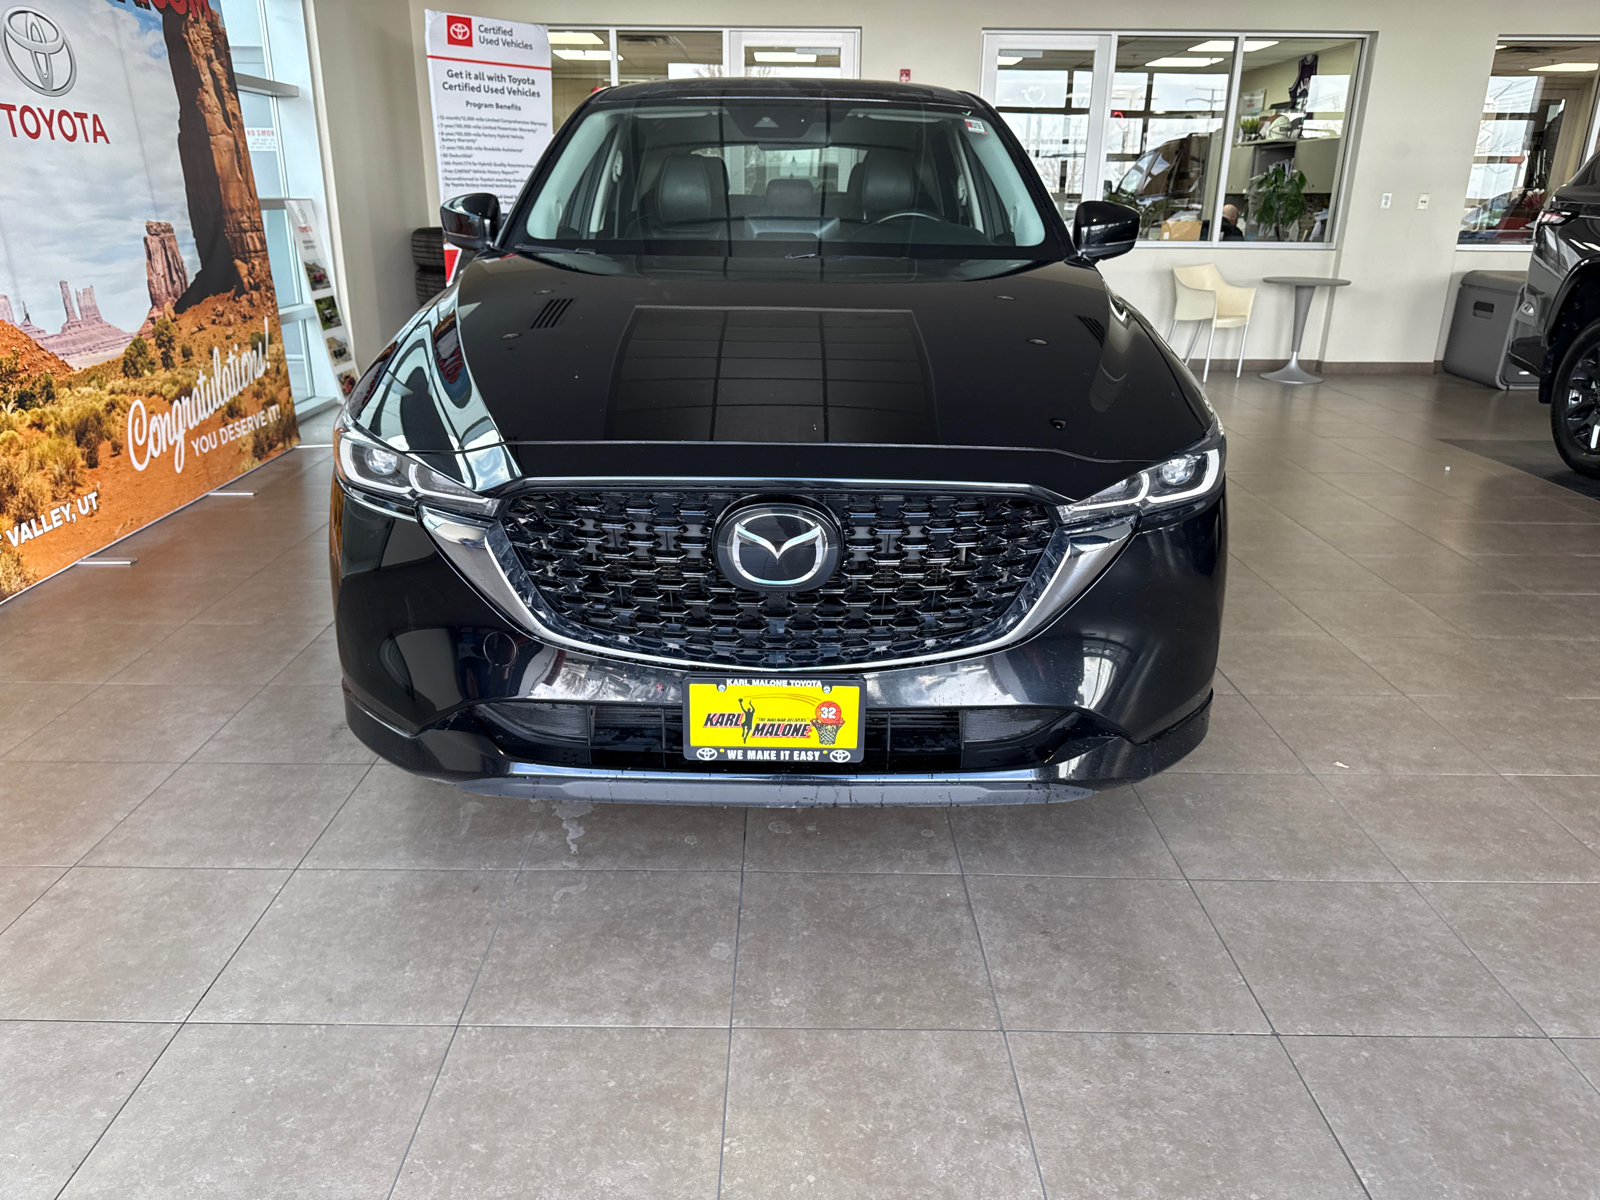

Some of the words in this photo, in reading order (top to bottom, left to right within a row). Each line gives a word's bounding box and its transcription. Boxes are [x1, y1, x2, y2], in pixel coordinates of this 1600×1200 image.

[478, 24, 513, 36] Certified
[479, 35, 500, 46] Used
[501, 38, 533, 50] Vehicles
[446, 69, 464, 79] Get
[465, 70, 472, 80] it
[474, 72, 485, 81] all
[487, 73, 506, 83] with
[507, 75, 535, 86] Toyota
[442, 82, 481, 93] Certified
[483, 85, 505, 95] Used
[506, 87, 540, 98] Vehicles
[466, 100, 494, 110] Program
[495, 102, 521, 111] Benefits
[0, 103, 110, 144] TOYOTA
[128, 316, 270, 473] Congratulations!
[191, 431, 218, 456] YOU
[219, 409, 268, 445] DESERVE
[268, 404, 281, 424] IT!
[5, 502, 76, 547] VALLEY,
[76, 492, 98, 515] UT
[703, 712, 744, 728] KARL
[820, 707, 836, 719] 32
[751, 723, 812, 738] MALONE
[727, 750, 745, 759] WE
[747, 750, 777, 760] MAKE
[780, 751, 790, 760] IT
[794, 751, 820, 761] EASY
